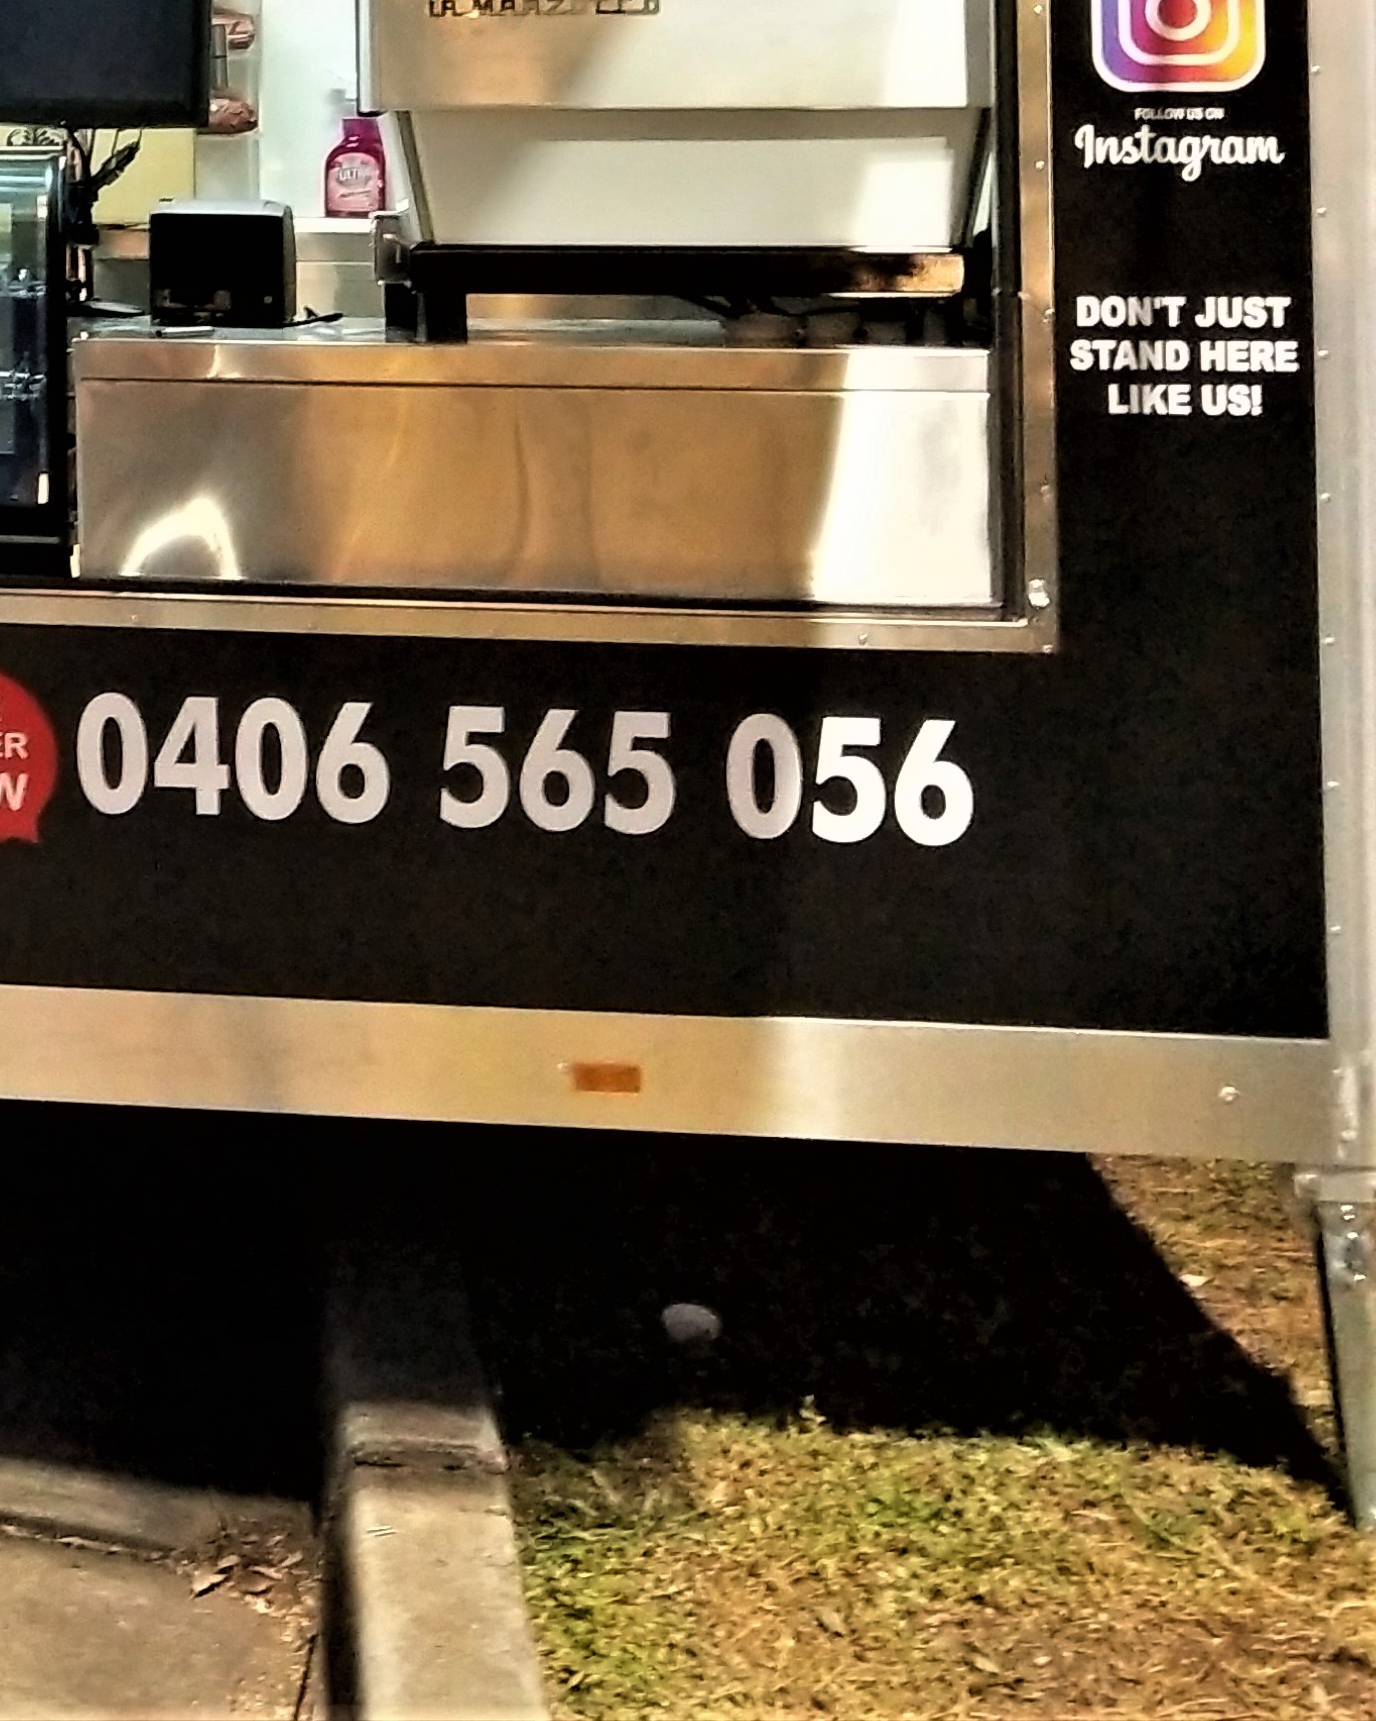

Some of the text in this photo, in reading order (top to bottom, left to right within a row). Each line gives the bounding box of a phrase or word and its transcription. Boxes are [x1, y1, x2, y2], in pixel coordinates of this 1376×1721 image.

[1133, 107, 1185, 121] FOLLOW
[1074, 122, 1286, 182] Instagram
[1076, 295, 1292, 329] DON'T JUST
[1069, 338, 1300, 373] STAND HERE
[1107, 383, 1264, 417] LIKE US!
[76, 692, 975, 847] 0406 565 056
